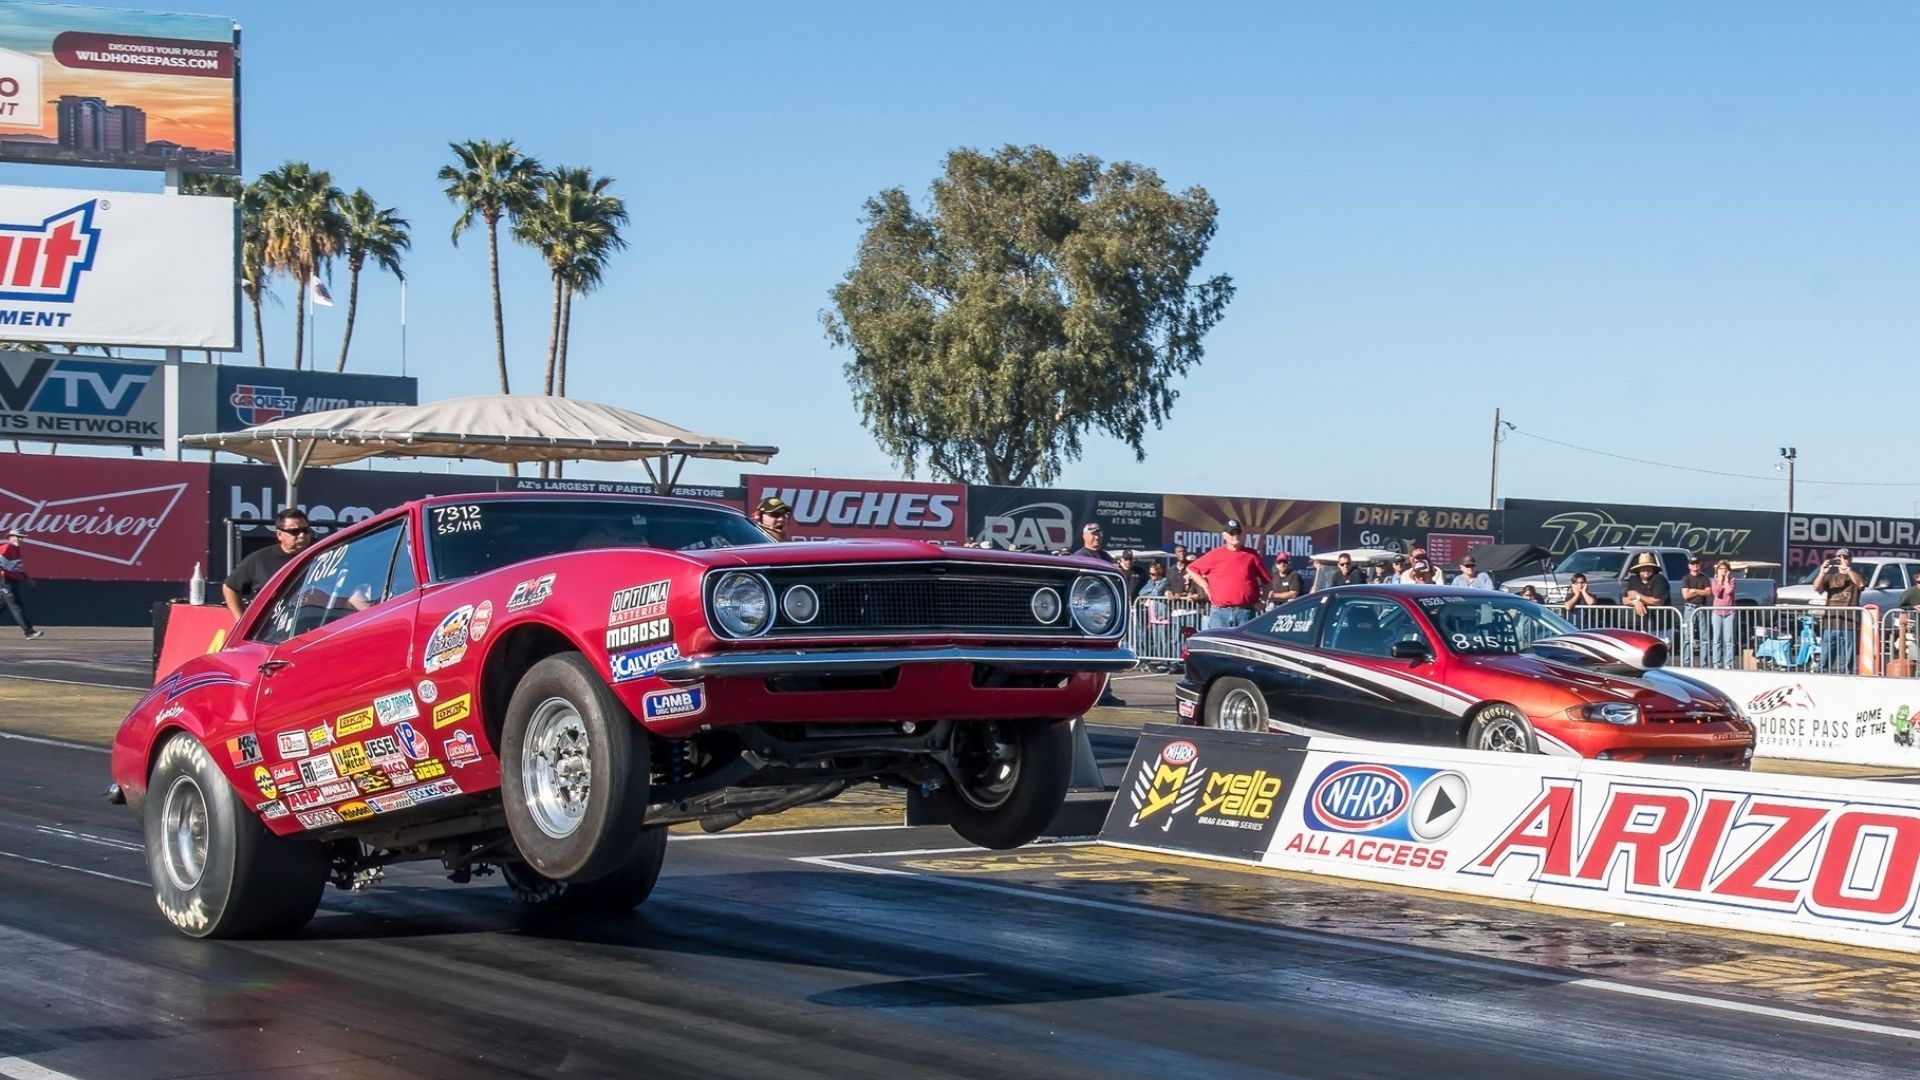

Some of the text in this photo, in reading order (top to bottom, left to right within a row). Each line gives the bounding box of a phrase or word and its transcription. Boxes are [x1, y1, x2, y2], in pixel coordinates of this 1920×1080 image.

[75, 50, 219, 69] WILDHORSEPASS.COM
[108, 43, 219, 57] DISCOVER YOUR PASS AT
[0, 220, 81, 289] it
[230, 394, 297, 413] CARQUEST
[37, 416, 159, 435] NETWORK
[517, 480, 725, 498] AZ's LARGEST RV PARTS ERSTORE
[434, 505, 482, 523] 7312
[760, 487, 959, 528] HUGHES
[1353, 506, 1490, 531] DRIFT & DRAG
[982, 515, 1073, 551] RAD
[1360, 530, 1380, 546] Go
[1266, 534, 1313, 556] RACING
[612, 581, 668, 612] OPTIMA
[611, 603, 666, 623] BATTERIES
[606, 618, 670, 649] MOROSO
[616, 647, 673, 676] CALVERT
[652, 693, 693, 709] LAMB
[655, 703, 694, 715] DISC BRAKES
[1856, 707, 1882, 724] HOME
[1760, 716, 1805, 736] HORSE
[1812, 719, 1849, 739] PASS
[1855, 722, 1887, 738] OF THE
[342, 746, 360, 760] Auto
[366, 737, 399, 760] JESEL
[1167, 741, 1194, 760] NHRA
[344, 756, 367, 772] Meter
[288, 790, 321, 807] ARP
[1325, 774, 1397, 817] NHRA
[1198, 816, 1264, 831] DRAG RACING SERIES
[1284, 832, 1448, 870] ALL ACCESS
[1460, 778, 1920, 927] ARIZO
